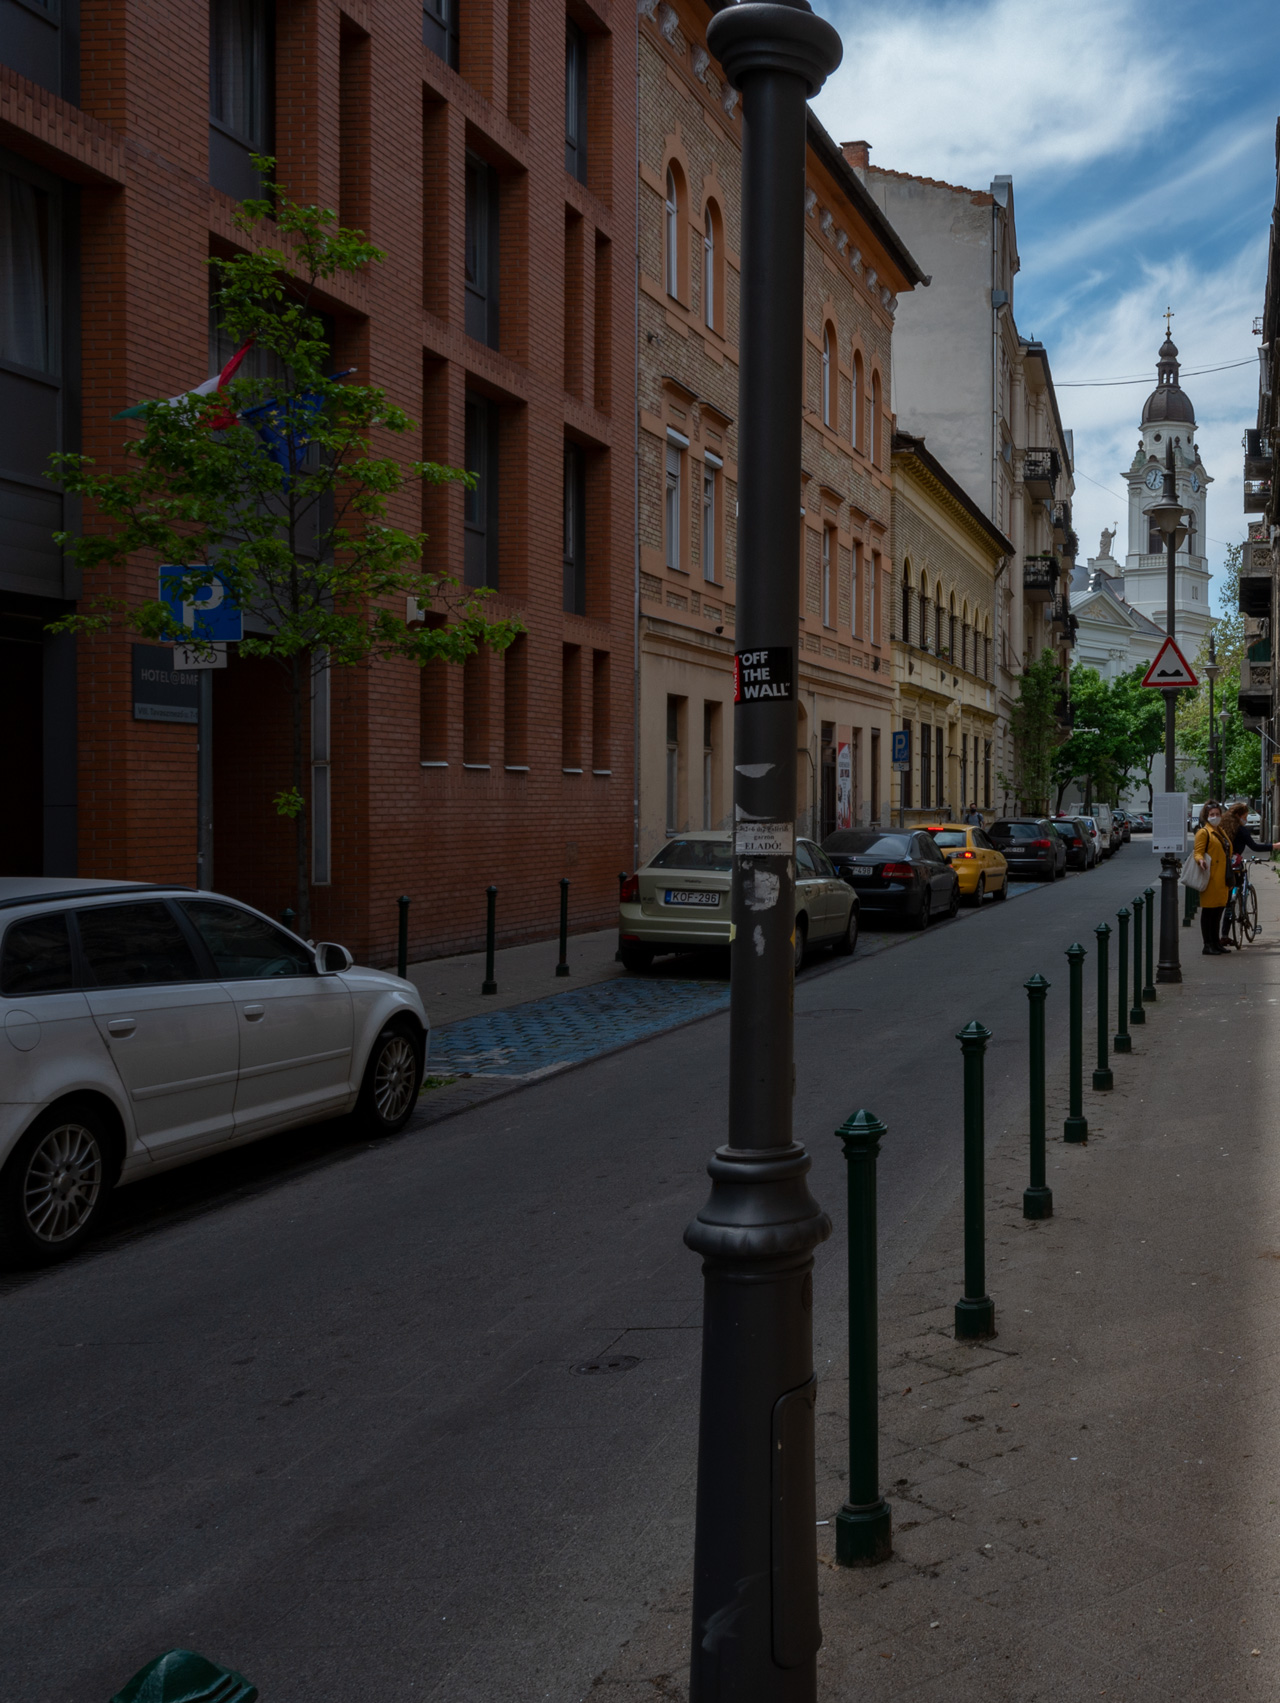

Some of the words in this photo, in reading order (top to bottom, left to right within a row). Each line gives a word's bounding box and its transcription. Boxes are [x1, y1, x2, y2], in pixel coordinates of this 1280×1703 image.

[183, 575, 224, 631] P
[141, 668, 198, 686] HOTEL@BMF
[743, 667, 770, 682] THE
[895, 734, 906, 759] P
[745, 840, 782, 850] ELADÓ!
[672, 892, 717, 903] KOF-296
